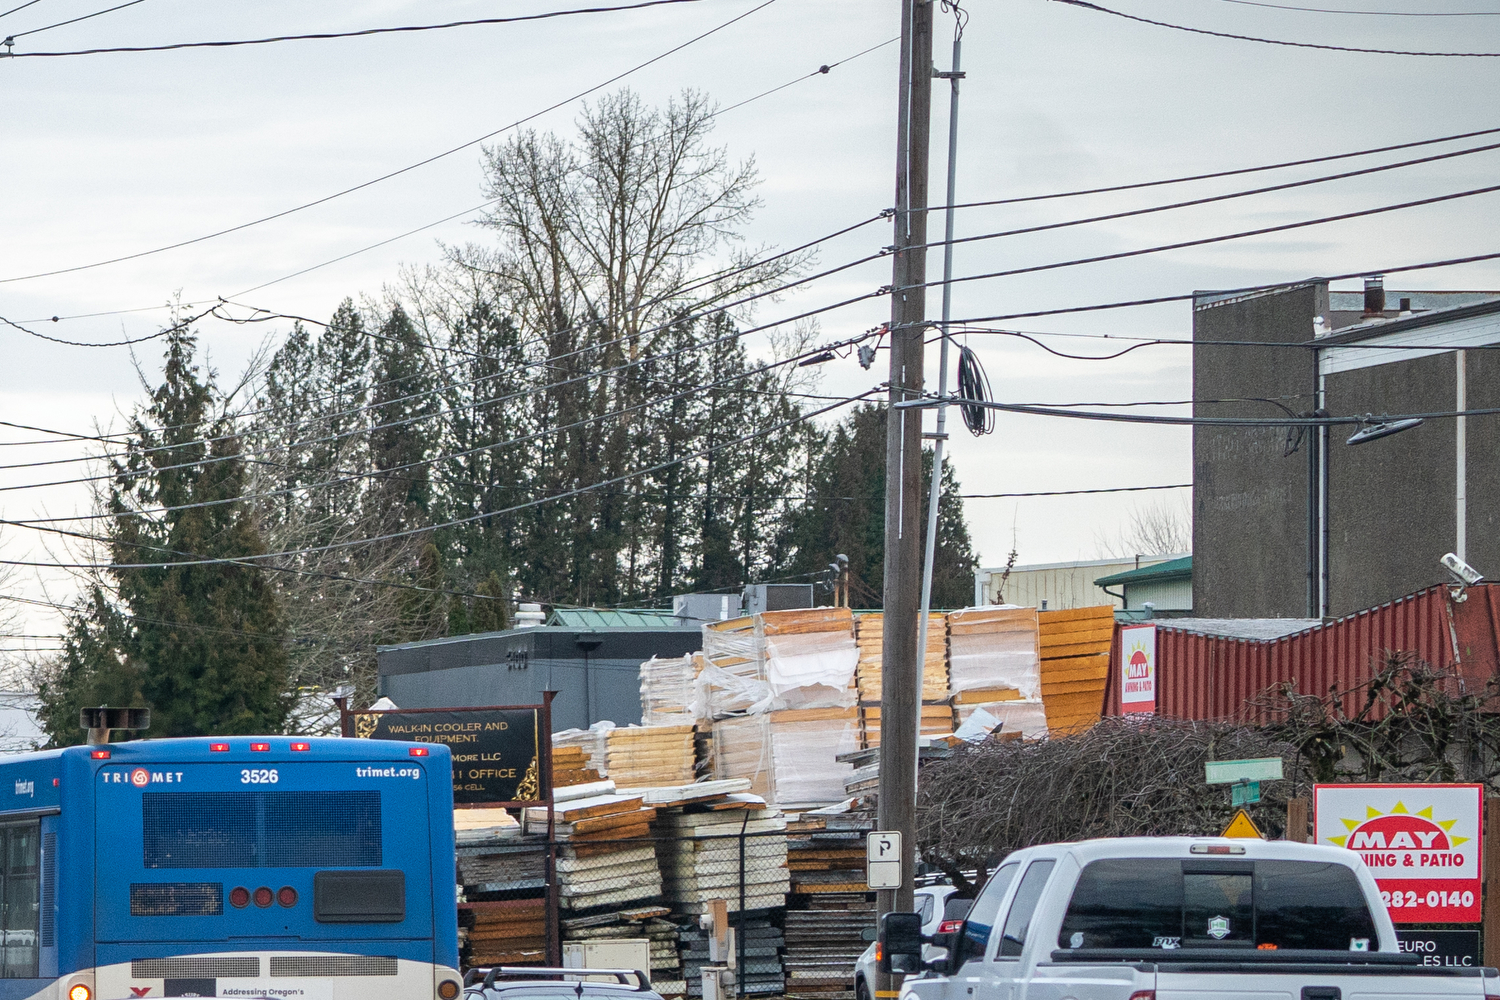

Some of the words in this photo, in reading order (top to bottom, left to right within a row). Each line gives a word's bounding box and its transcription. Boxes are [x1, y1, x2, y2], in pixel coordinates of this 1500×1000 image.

[1128, 663, 1147, 678] MAY
[388, 724, 432, 733] WALK-IN
[434, 722, 481, 732] COOLER
[484, 722, 509, 731] AND
[240, 769, 279, 784] 3526
[356, 766, 420, 780] trimet.org
[469, 768, 517, 779] OFFICE
[1351, 831, 1440, 849] MAY
[1403, 853, 1414, 867] &
[1420, 853, 1465, 867] PATIO
[1397, 941, 1436, 952] EURO
[1445, 955, 1472, 967] LLC
[222, 988, 267, 997] Addressing
[269, 988, 304, 997] Oregon's
